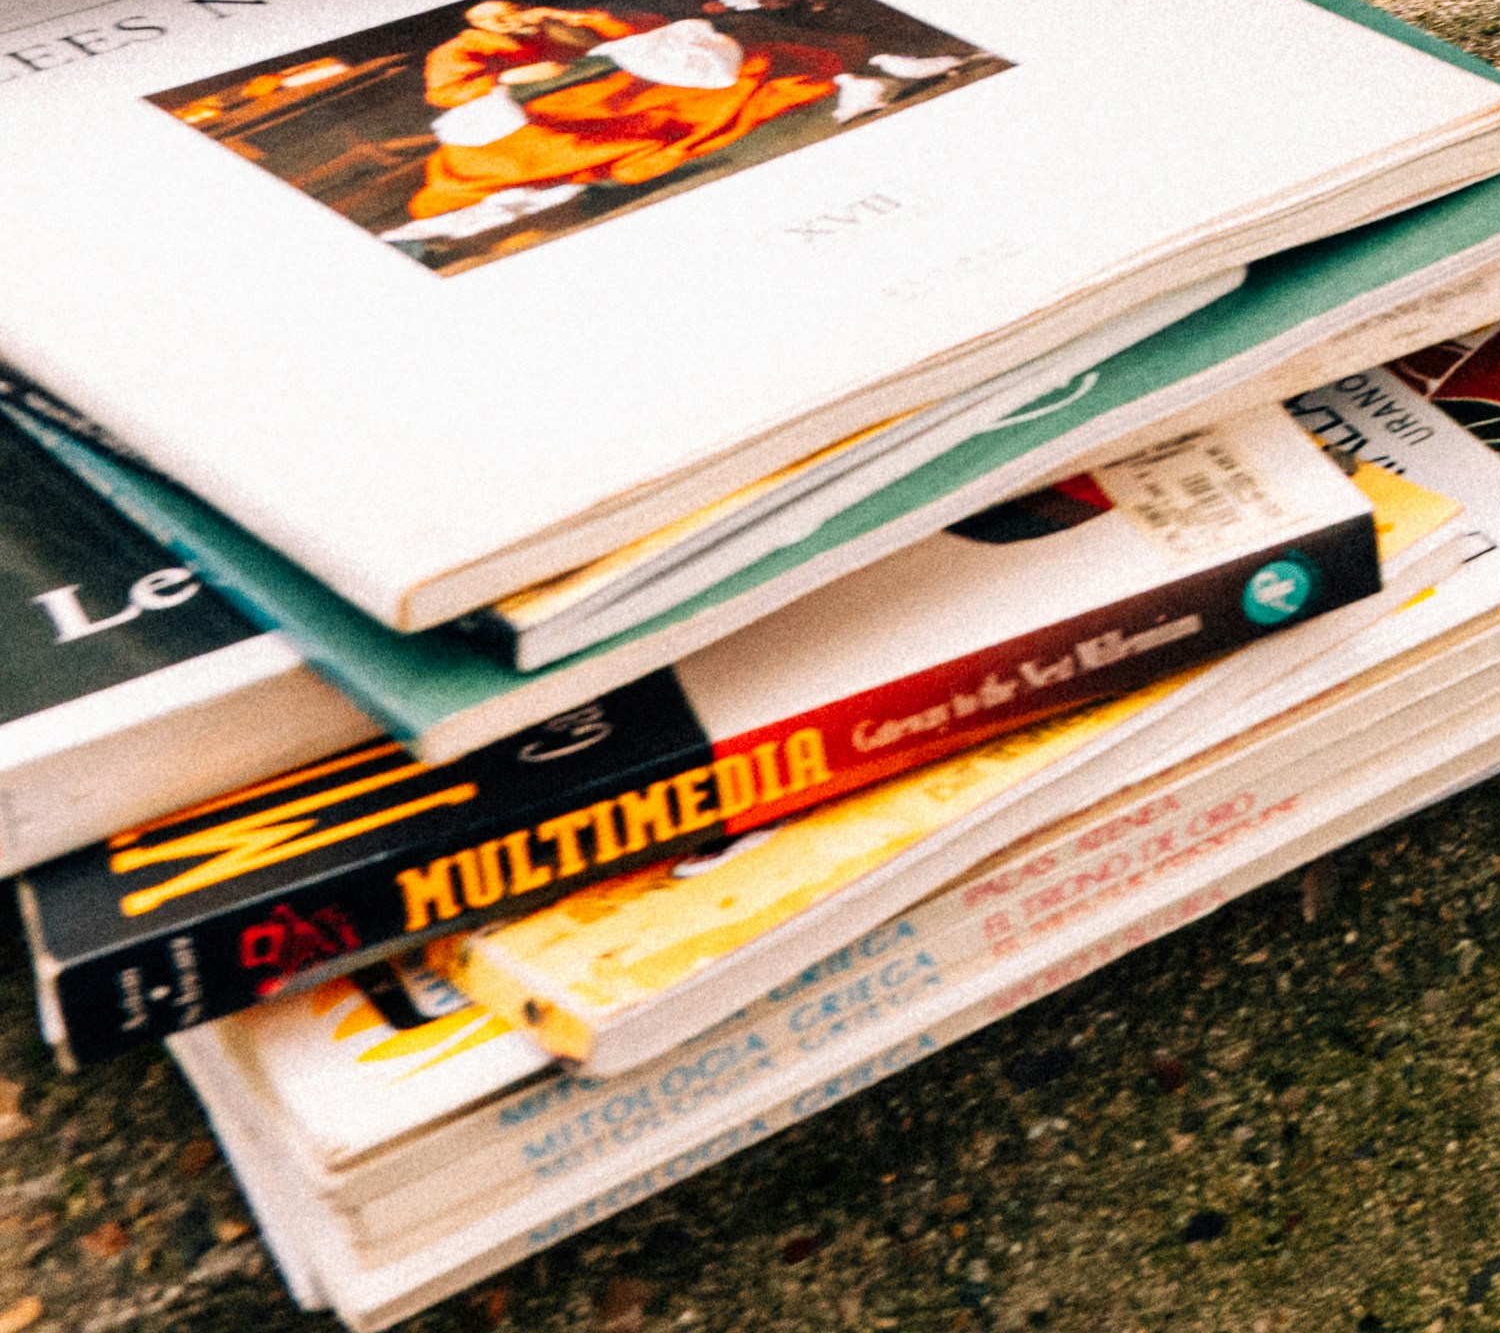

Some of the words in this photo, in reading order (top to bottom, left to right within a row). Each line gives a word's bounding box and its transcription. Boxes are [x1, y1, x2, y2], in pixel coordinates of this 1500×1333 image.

[1335, 371, 1436, 447] URANO
[394, 727, 832, 933] MULTIMEDIA
[521, 1031, 769, 1162] MITOLOGIA
[787, 948, 937, 1034] GRIEGA
